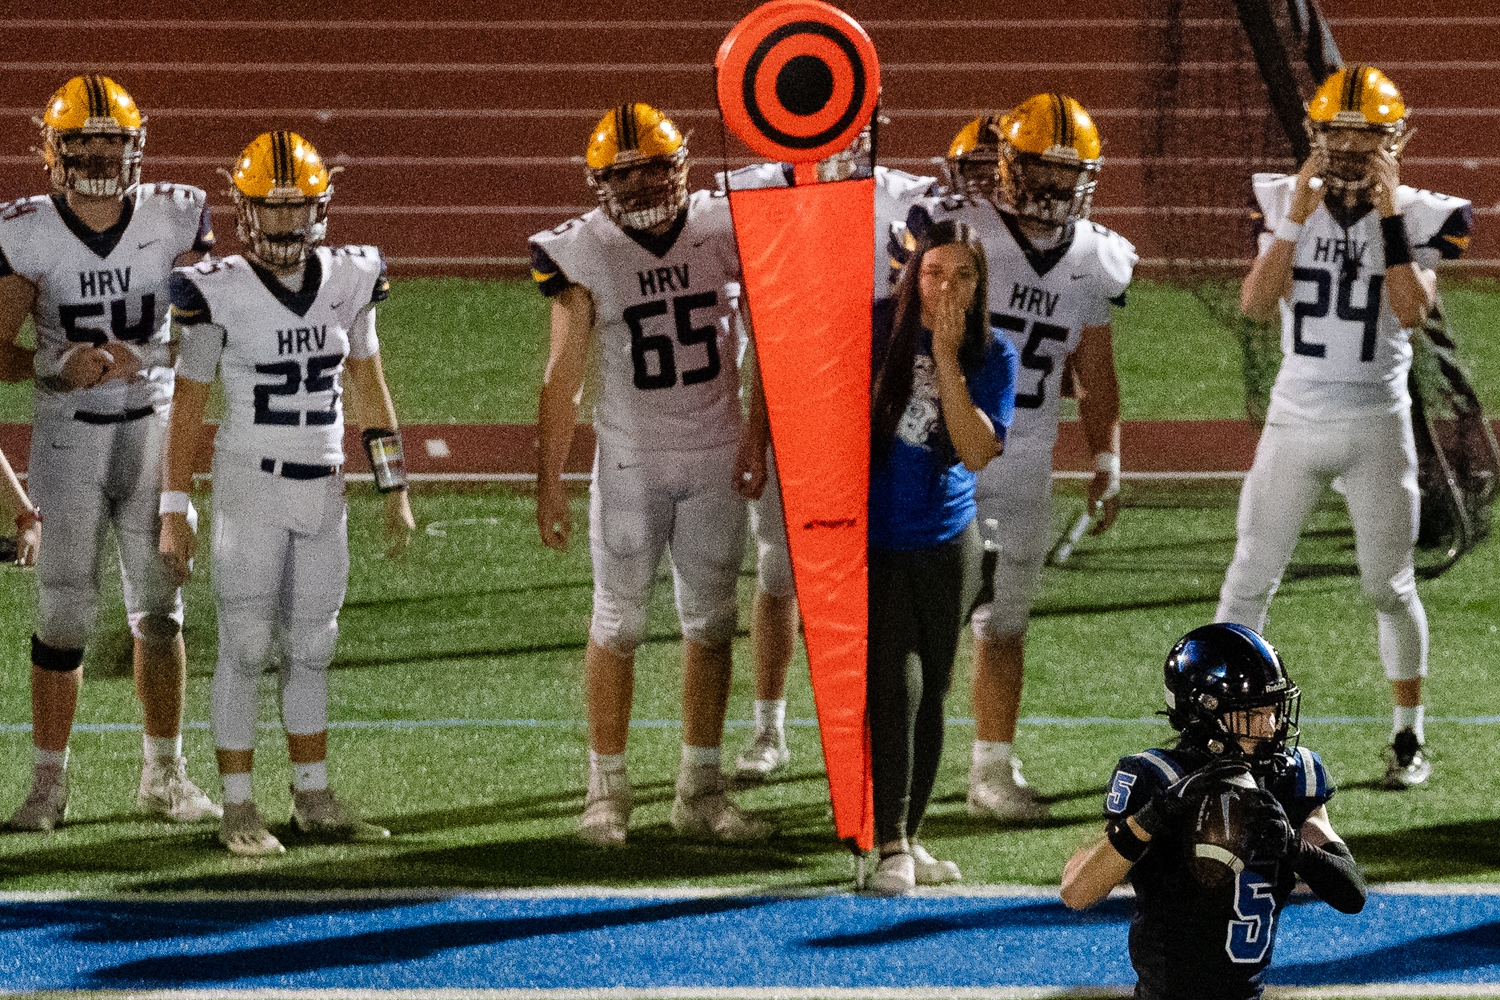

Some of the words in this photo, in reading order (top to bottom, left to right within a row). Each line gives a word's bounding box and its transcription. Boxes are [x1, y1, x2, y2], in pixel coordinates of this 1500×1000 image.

[80, 266, 132, 299] HRV
[636, 263, 689, 296] HRV
[1009, 282, 1060, 317] HRV
[1293, 267, 1385, 362] 24
[277, 323, 327, 355] HRV
[623, 291, 721, 390] 65
[253, 353, 344, 426] 25
[1106, 770, 1138, 814] 5
[1225, 860, 1278, 963] 5
